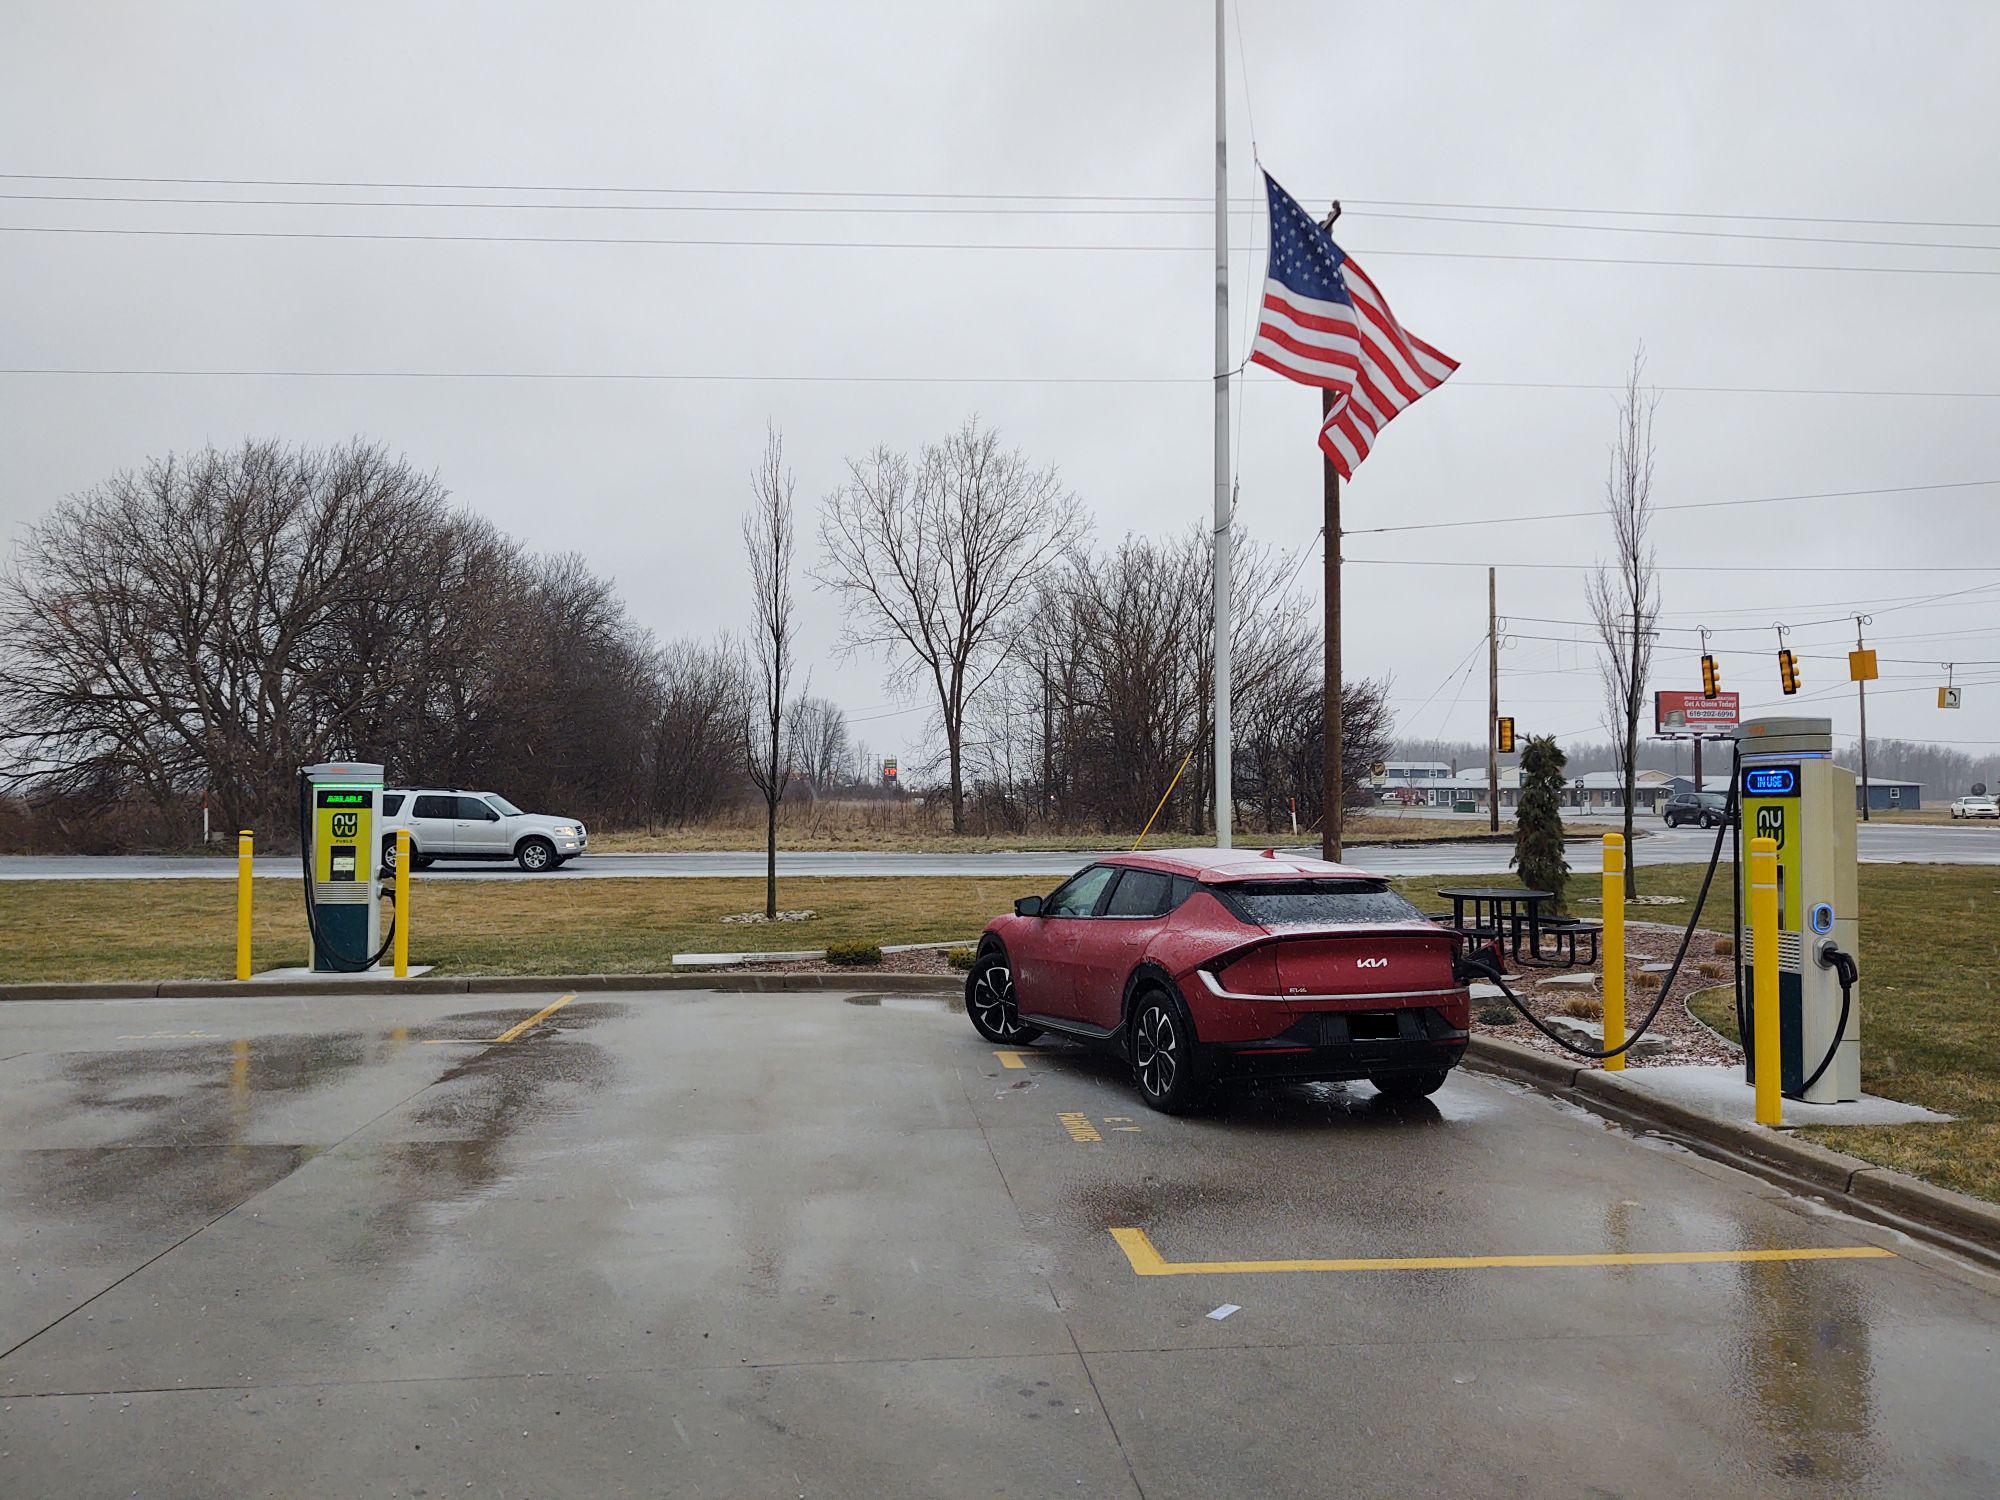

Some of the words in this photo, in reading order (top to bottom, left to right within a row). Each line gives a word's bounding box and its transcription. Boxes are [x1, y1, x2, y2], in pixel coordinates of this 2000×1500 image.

[1757, 776, 1766, 787] IN
[1766, 776, 1782, 787] USE
[1356, 957, 1388, 968] KIA
